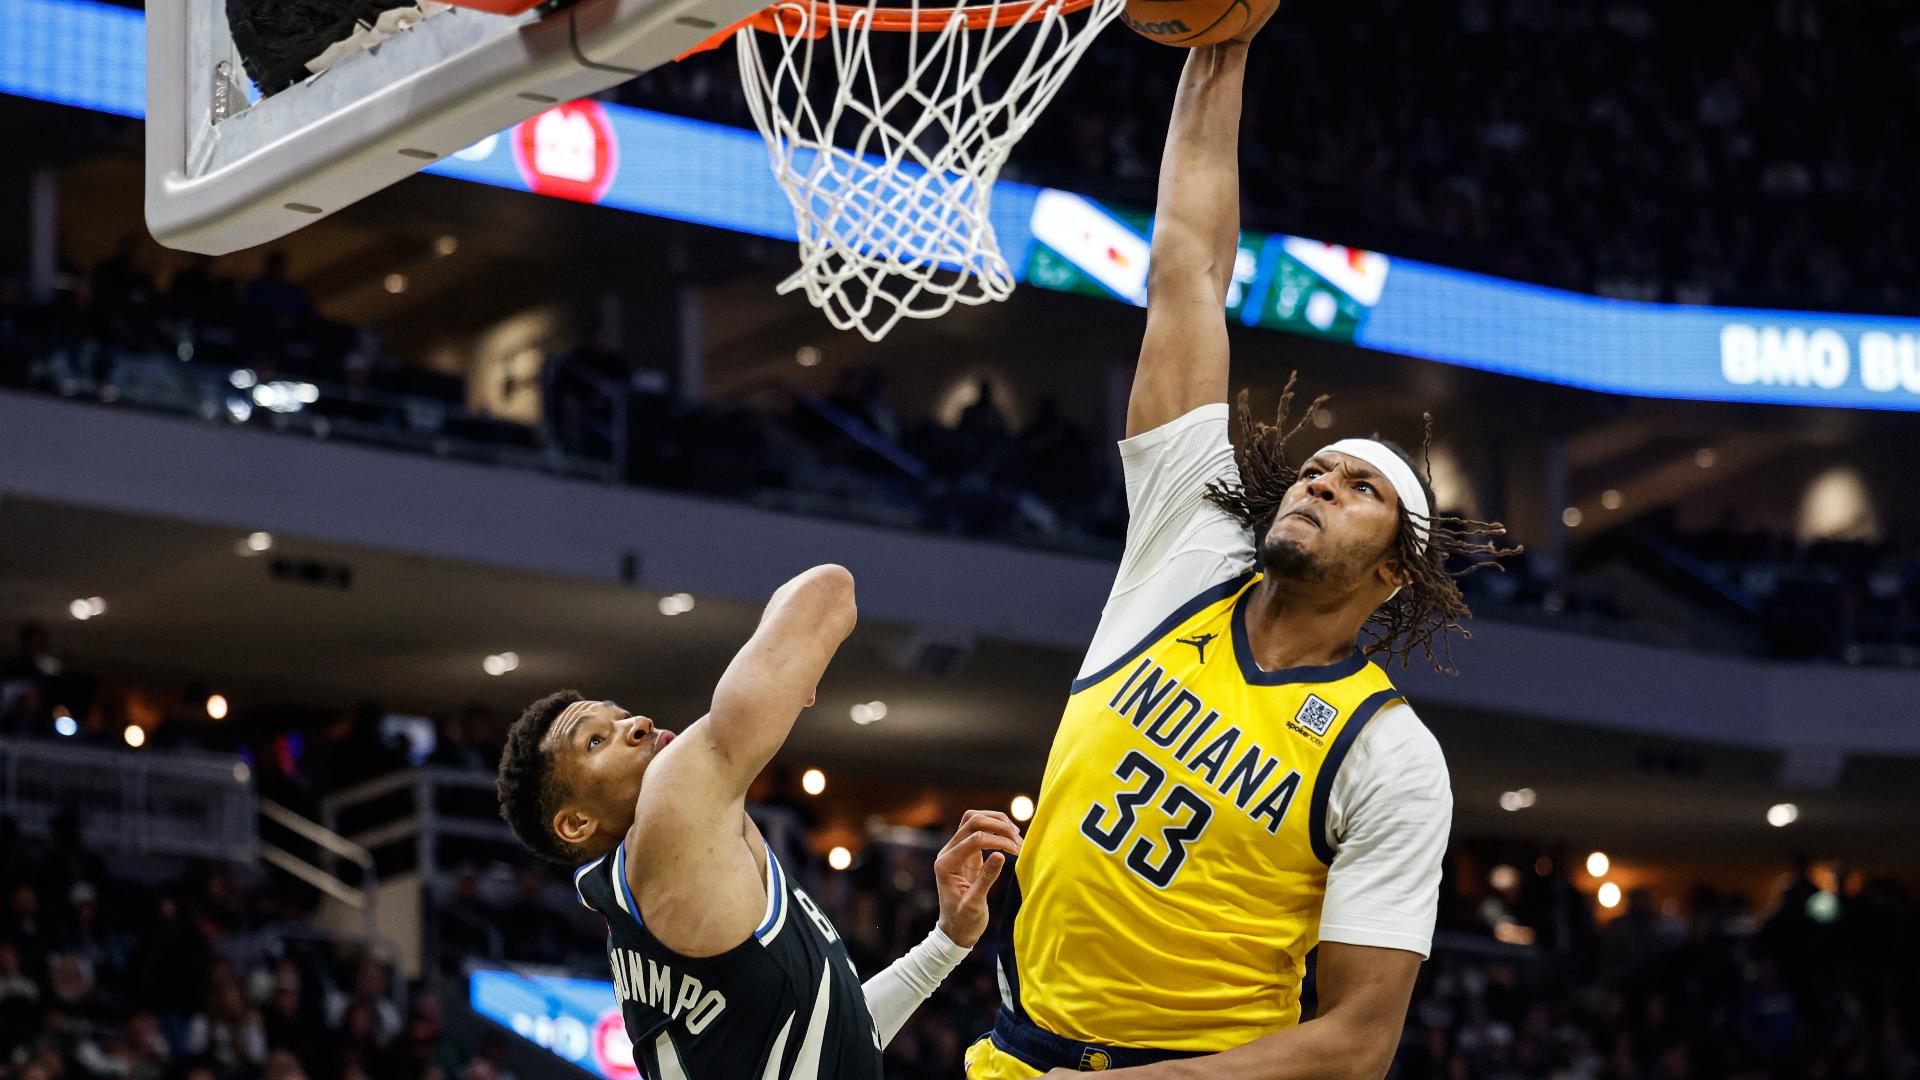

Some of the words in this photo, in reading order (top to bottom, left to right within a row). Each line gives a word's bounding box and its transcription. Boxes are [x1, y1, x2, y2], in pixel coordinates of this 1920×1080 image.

[1720, 323, 1850, 389] BMO
[1109, 657, 1301, 835] INDIANA
[1079, 750, 1213, 889] 33
